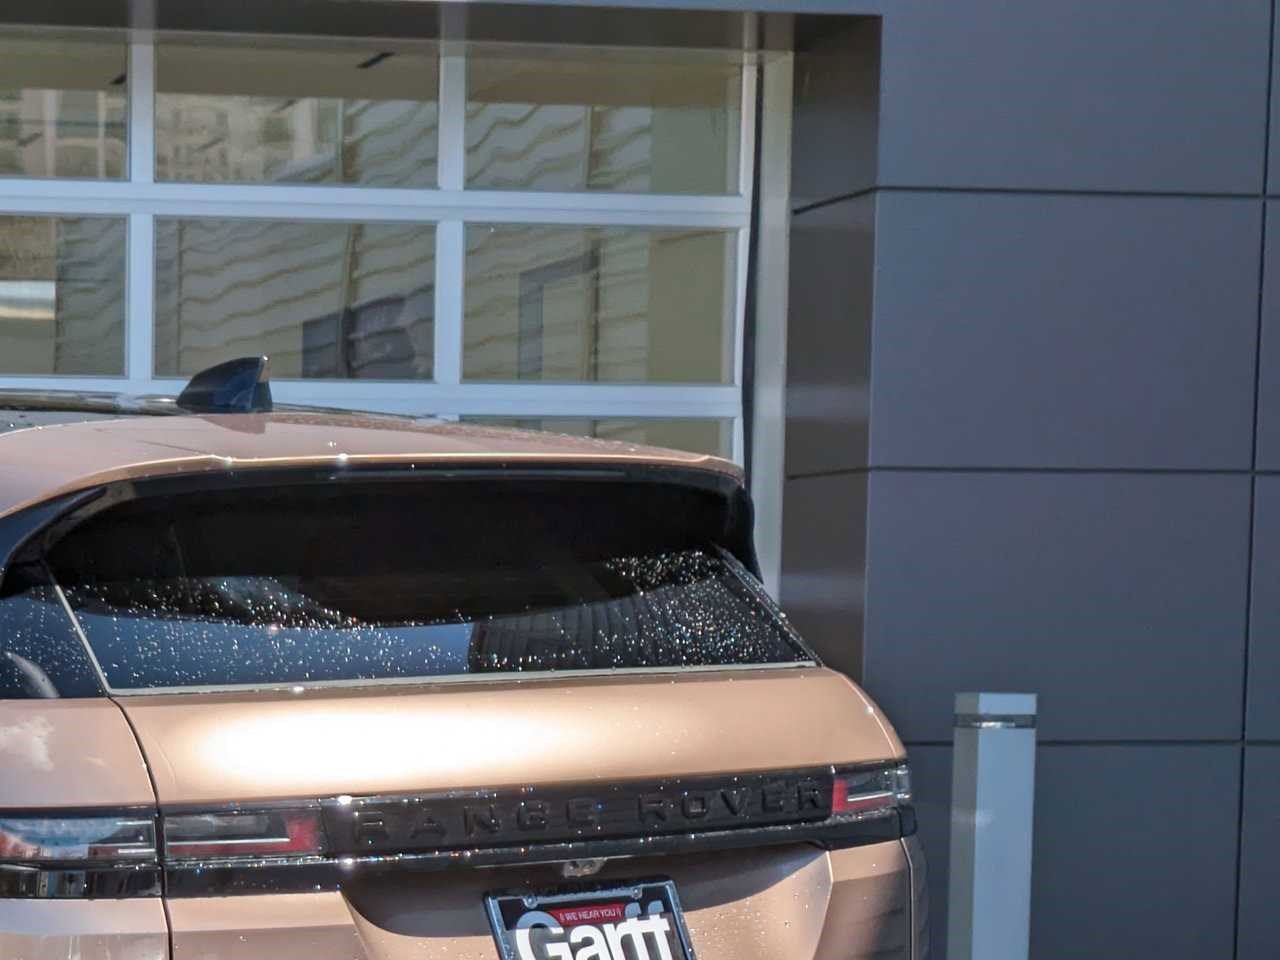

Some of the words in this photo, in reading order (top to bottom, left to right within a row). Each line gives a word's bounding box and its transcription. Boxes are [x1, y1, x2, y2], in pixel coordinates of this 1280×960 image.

[352, 798, 597, 843] RANGE
[637, 780, 822, 824] ROVER
[579, 908, 600, 920] HEAR
